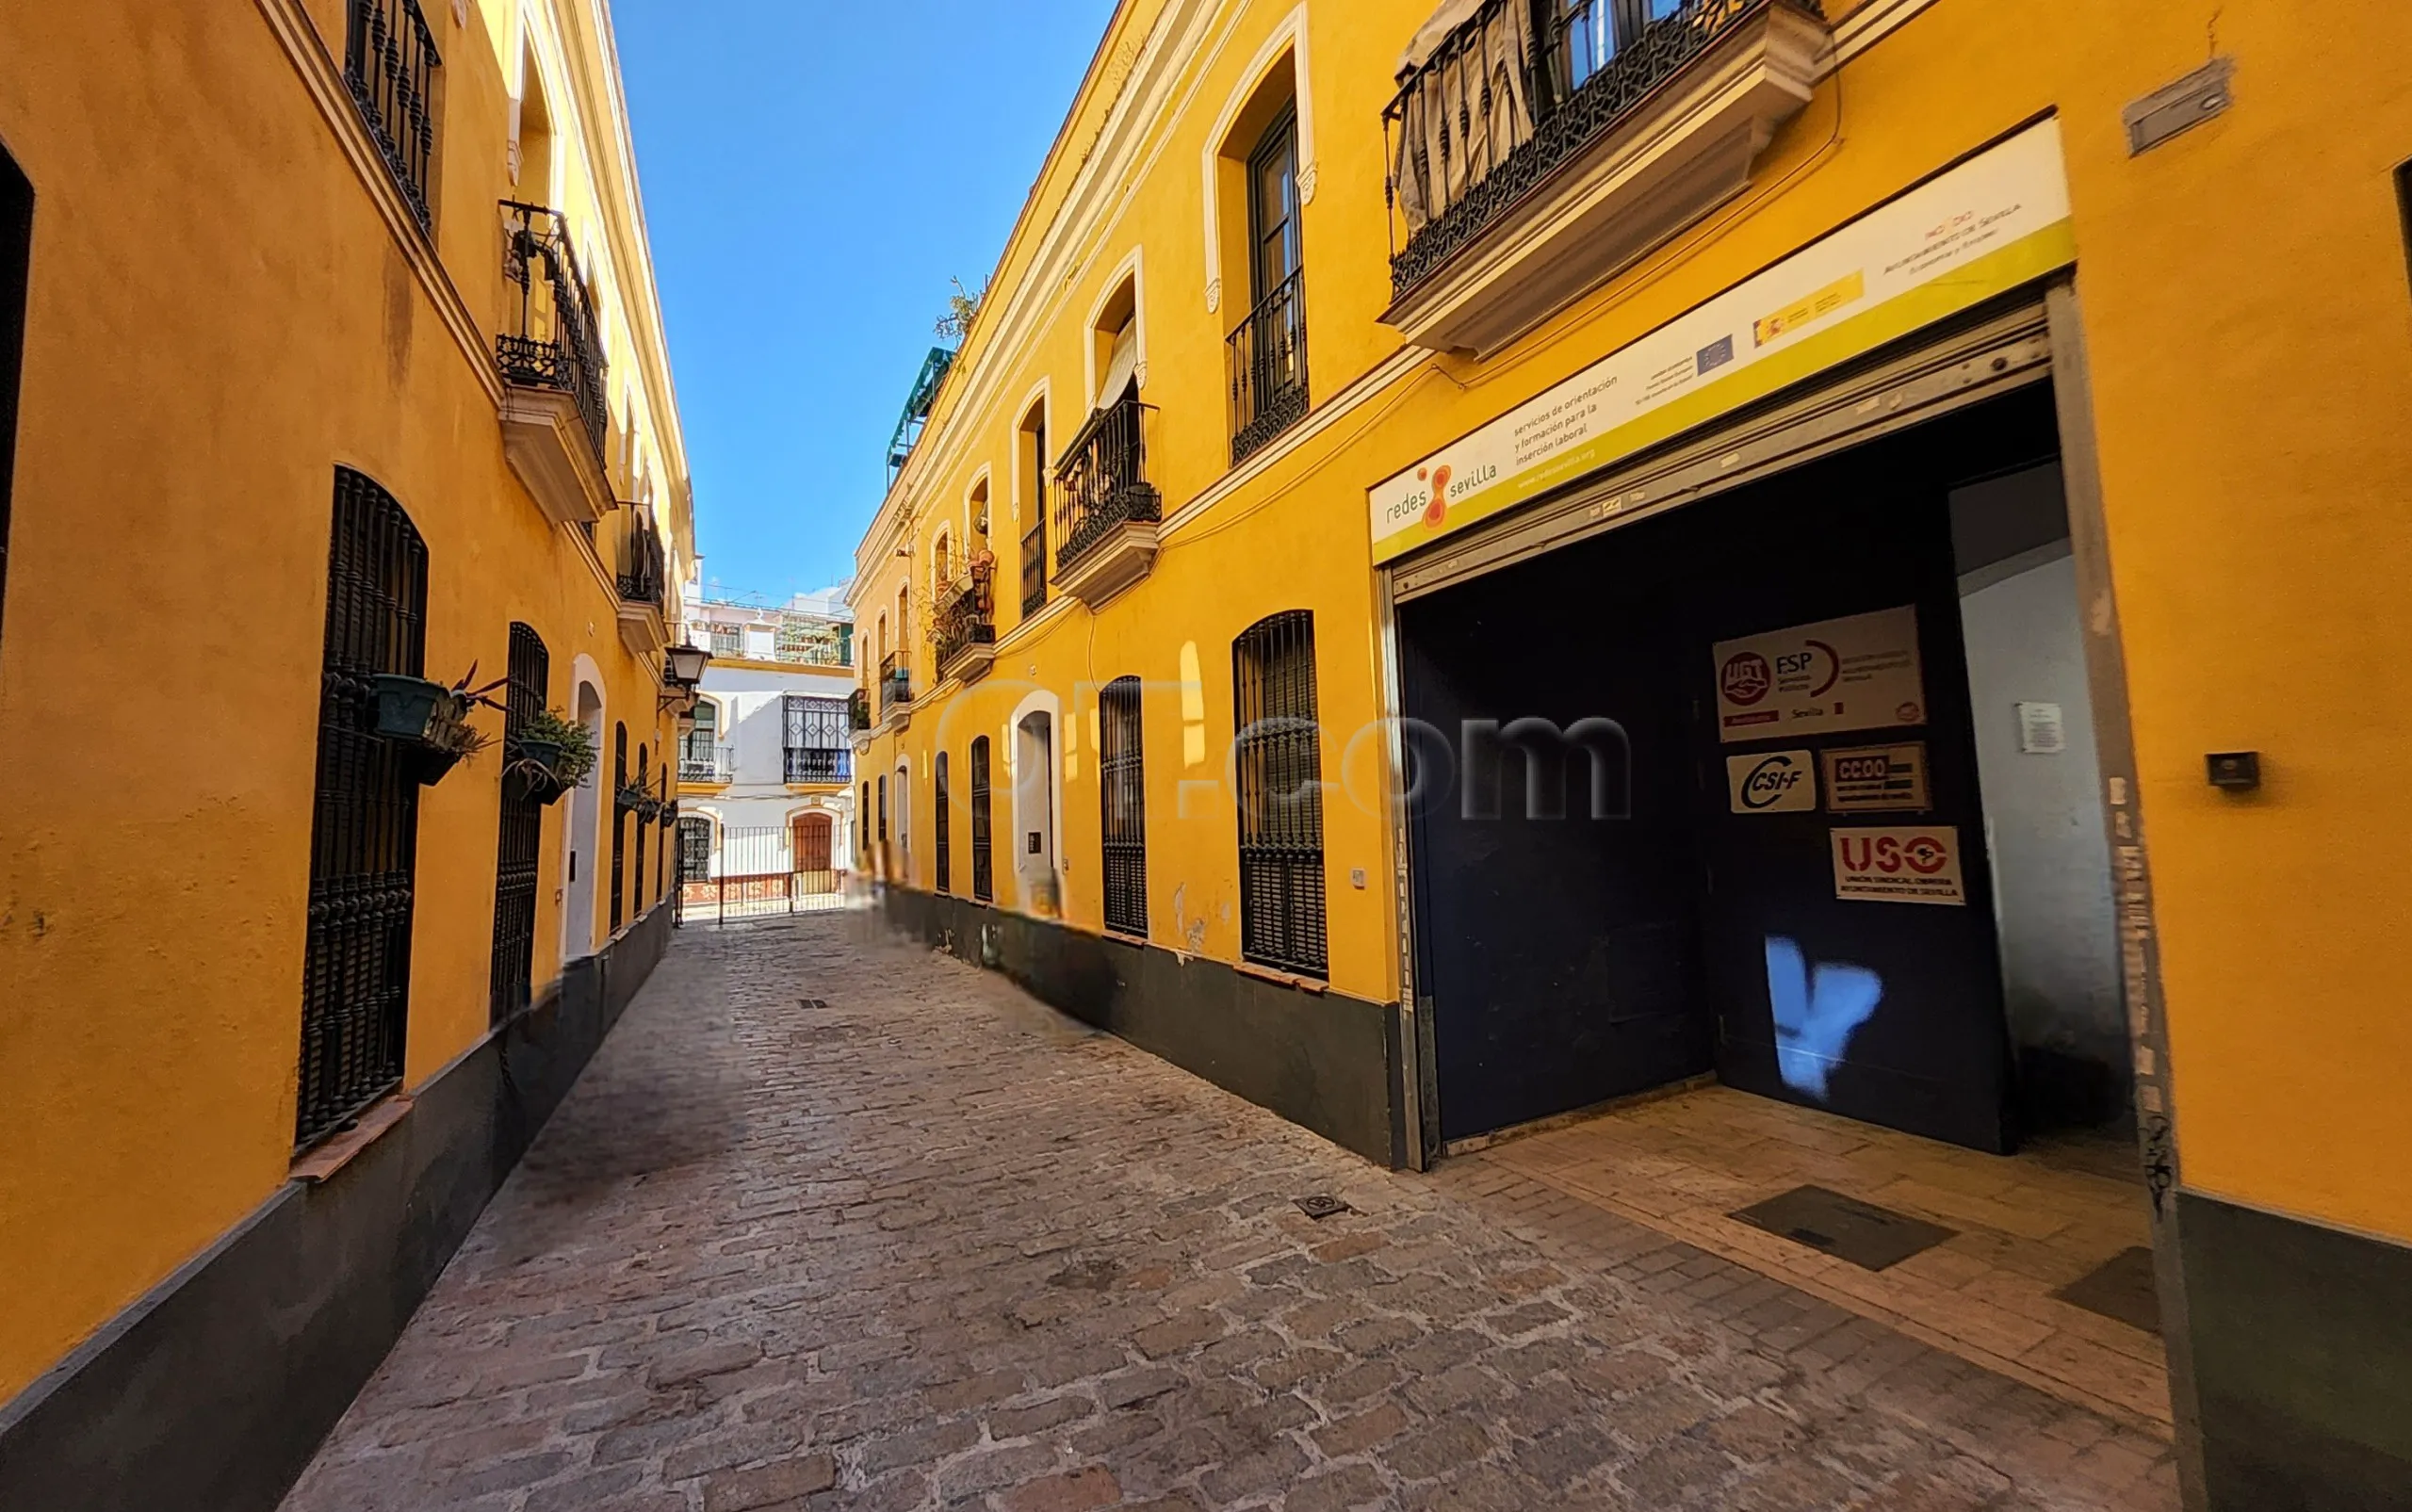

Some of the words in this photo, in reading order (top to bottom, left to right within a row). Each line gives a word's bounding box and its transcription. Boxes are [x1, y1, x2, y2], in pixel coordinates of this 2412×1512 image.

[1514, 411, 1551, 437] servicios
[1552, 405, 1563, 417] de
[1564, 376, 1618, 410] orientación
[1514, 443, 1521, 453] y
[1521, 420, 1564, 448] formación
[1565, 409, 1586, 428] para
[1587, 404, 1598, 415] la
[1516, 441, 1554, 465] inserción
[1556, 423, 1588, 447] laboral
[1387, 490, 1427, 525] redes
[1450, 464, 1497, 497] sevilla
[1726, 658, 1764, 679] UGT
[1839, 836, 1948, 874] USO
